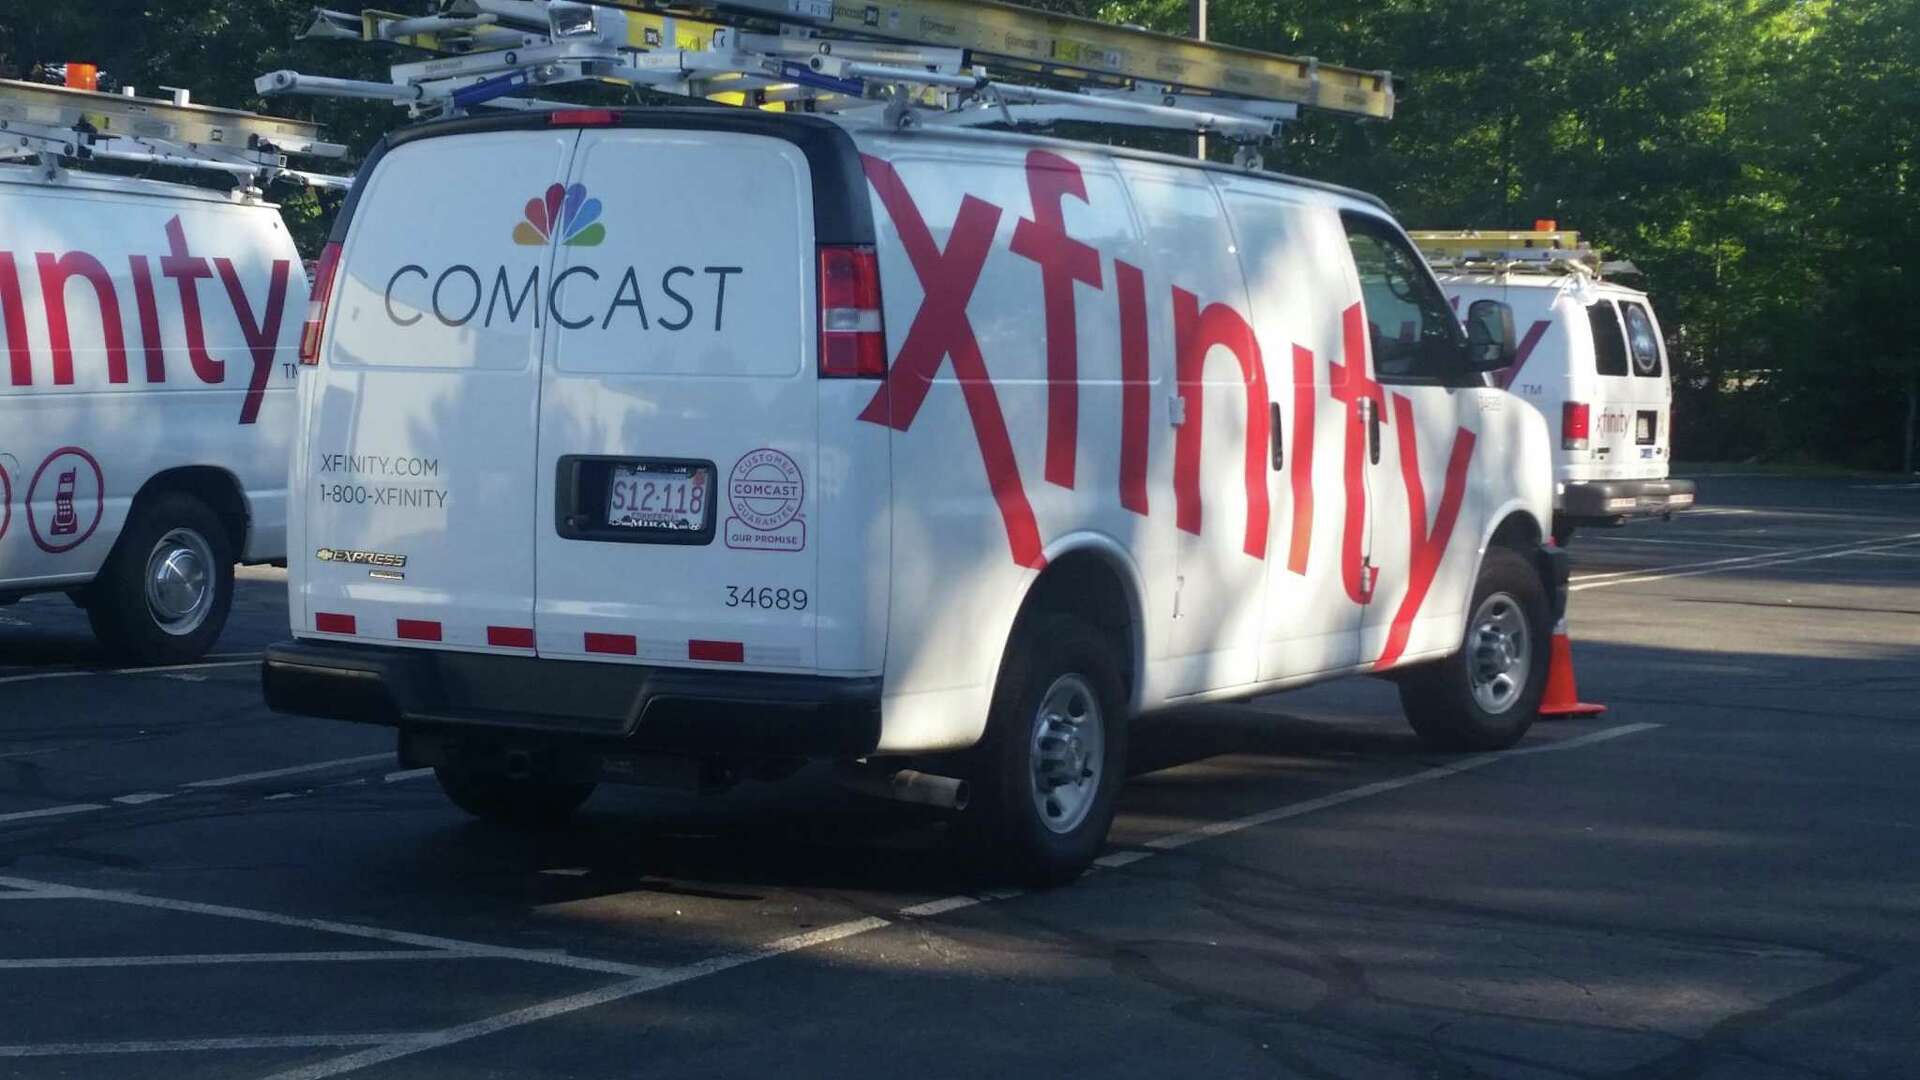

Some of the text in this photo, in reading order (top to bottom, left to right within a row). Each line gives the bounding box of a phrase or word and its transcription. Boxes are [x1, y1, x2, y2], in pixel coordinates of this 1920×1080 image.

[385, 264, 743, 332] COMCAST
[1522, 384, 1542, 395] TM
[857, 150, 1475, 671] xfinity
[321, 454, 438, 477] XFINITY.COM
[738, 453, 795, 476] CUSTOMER
[320, 483, 447, 508] 1-800-XFINITY
[734, 484, 798, 497] COMCAST
[737, 502, 794, 527] GUARANTEE
[732, 533, 798, 545] OUR PROMISE
[332, 550, 406, 567] EXPRESS
[725, 585, 808, 611] 34689
